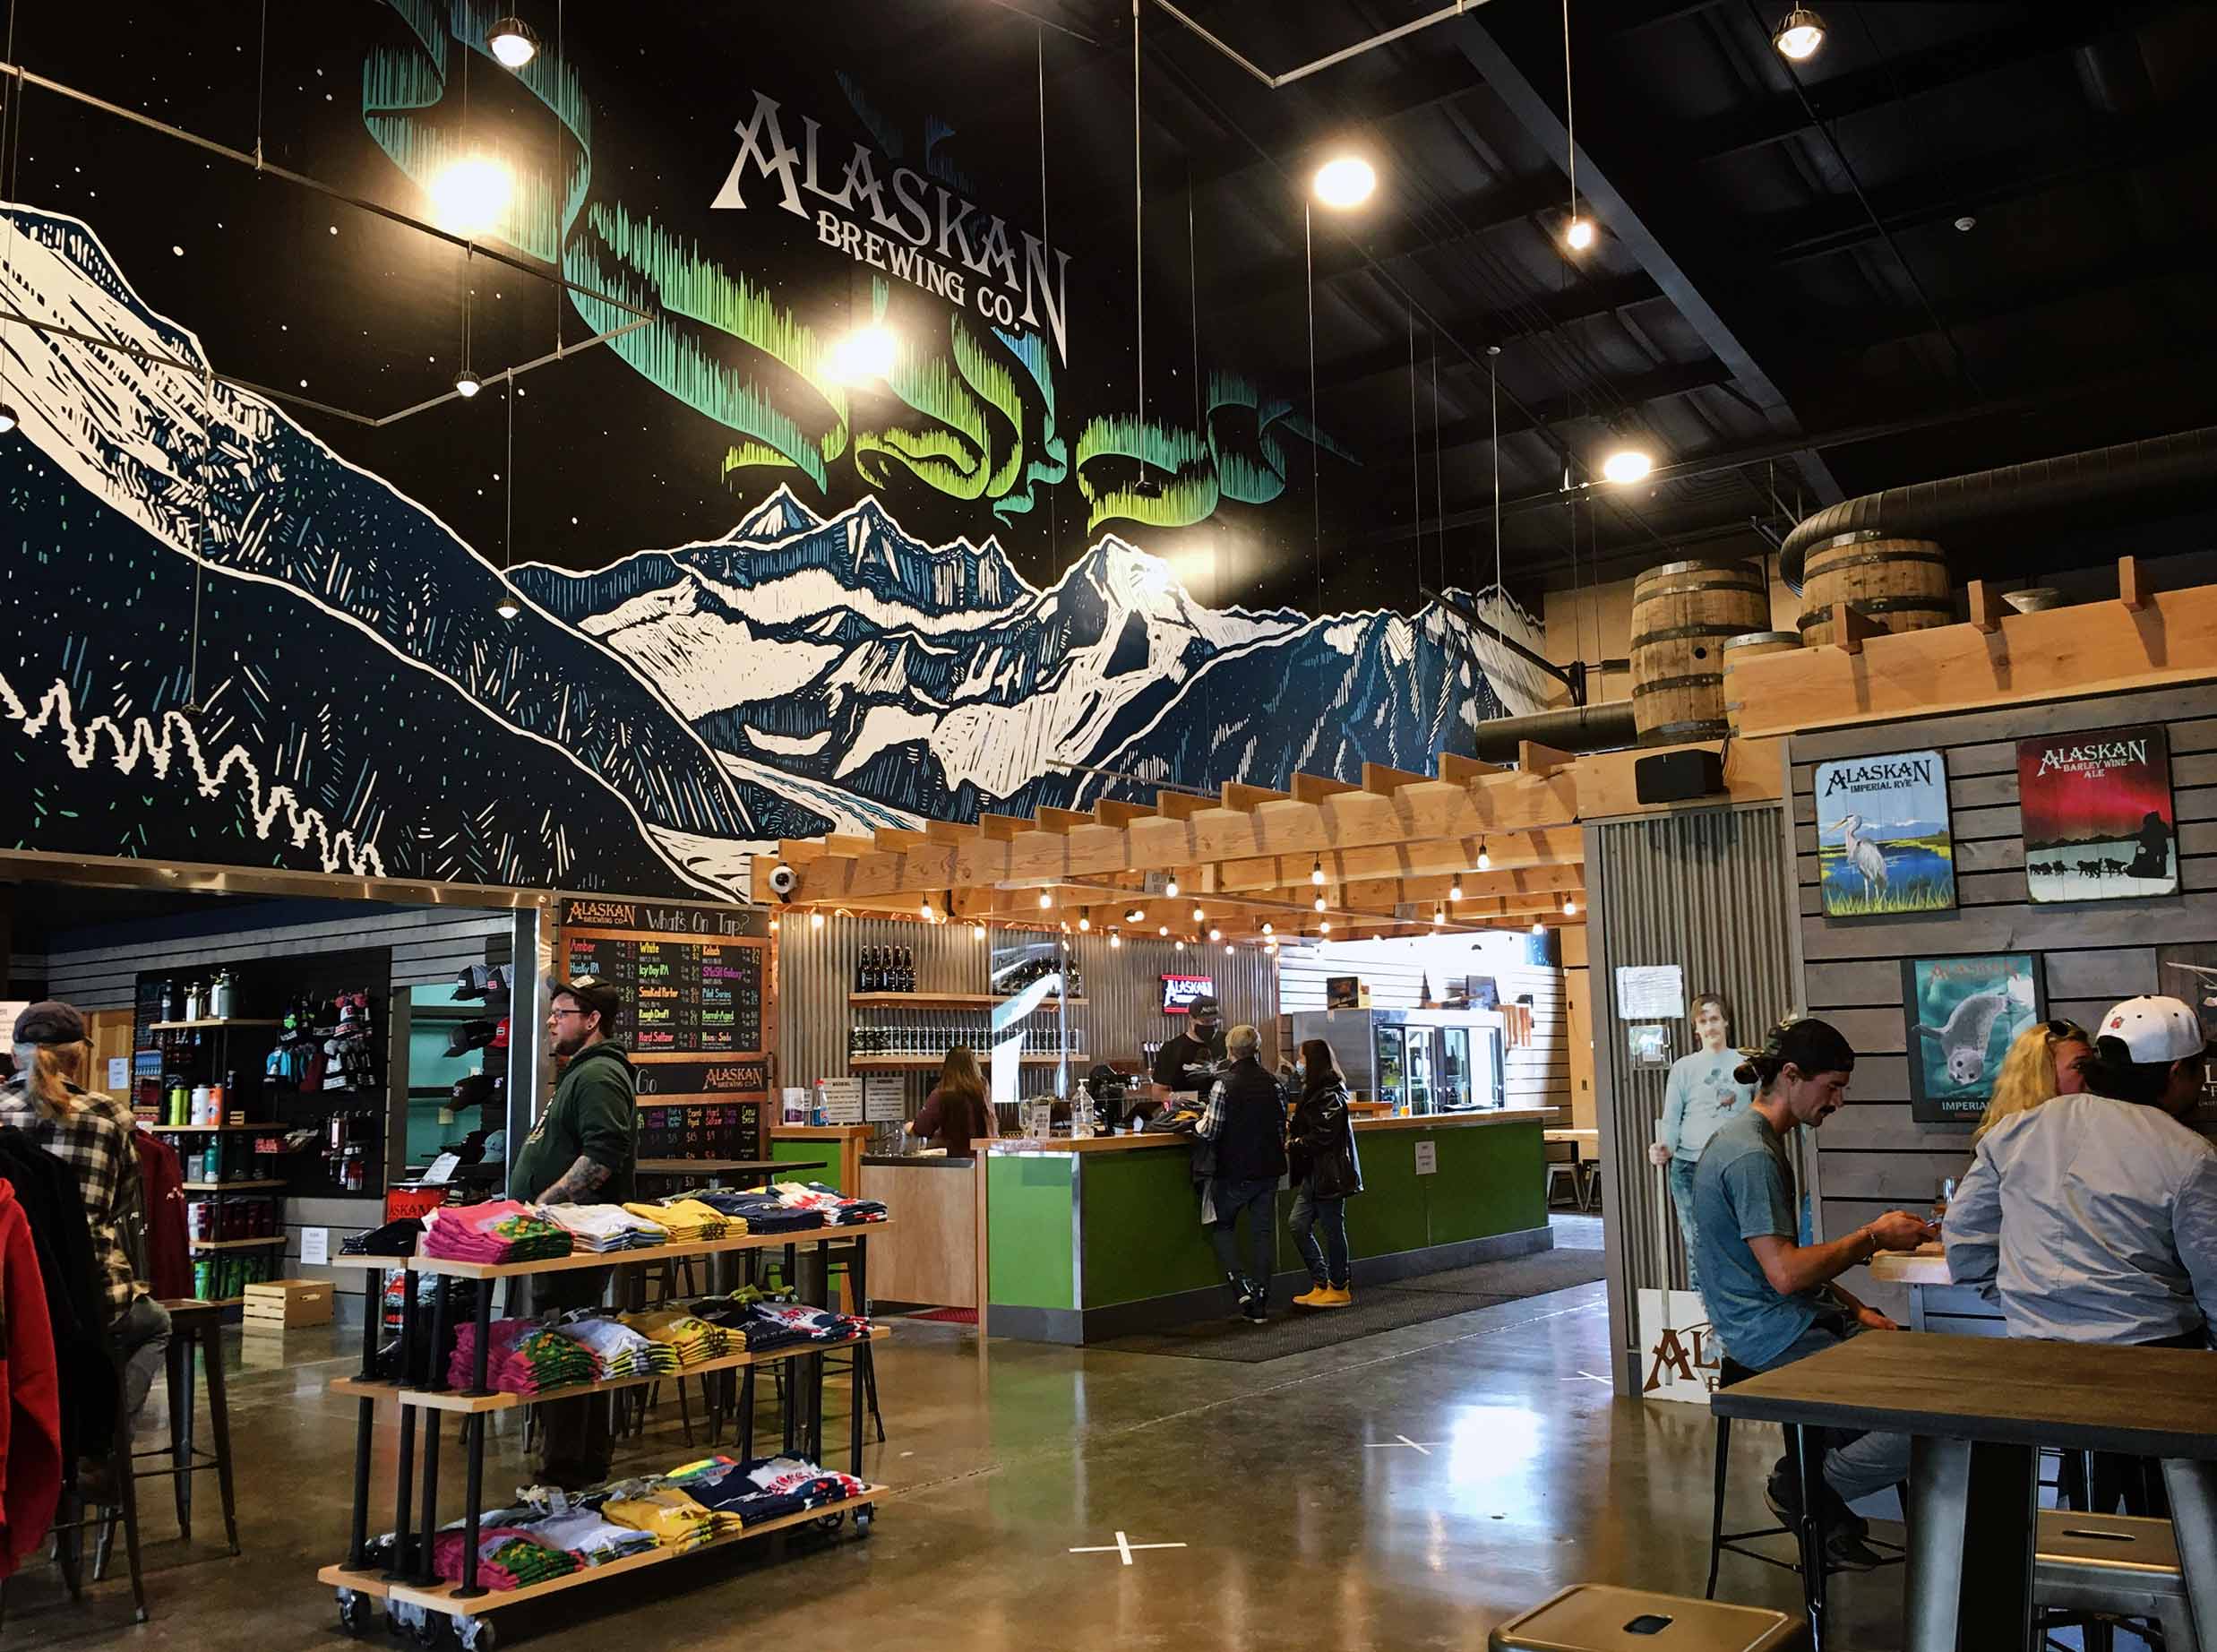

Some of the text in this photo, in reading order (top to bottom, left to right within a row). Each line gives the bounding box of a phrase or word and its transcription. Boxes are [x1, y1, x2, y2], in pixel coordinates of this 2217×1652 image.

[709, 90, 1073, 369] ALASKAN
[816, 210, 1021, 331] BREWING CO.
[2036, 739, 2147, 778] ALASKAN
[2063, 758, 2127, 772] BARLEY WINE
[1825, 760, 1931, 797] ALASKAN
[2084, 769, 2105, 779] ALE
[1851, 779, 1912, 793] IMPERIAL RYE
[566, 902, 637, 926] ALASKAN
[646, 909, 750, 937] What's On Tap?
[570, 939, 595, 952] Amber
[640, 942, 659, 954] White
[570, 962, 599, 975] Husky IPA
[639, 965, 649, 976] Icy
[660, 965, 669, 976] IPA
[639, 1032, 653, 1042] Hard
[635, 1068, 657, 1094] Go
[702, 1067, 762, 1090] ALASKAN
